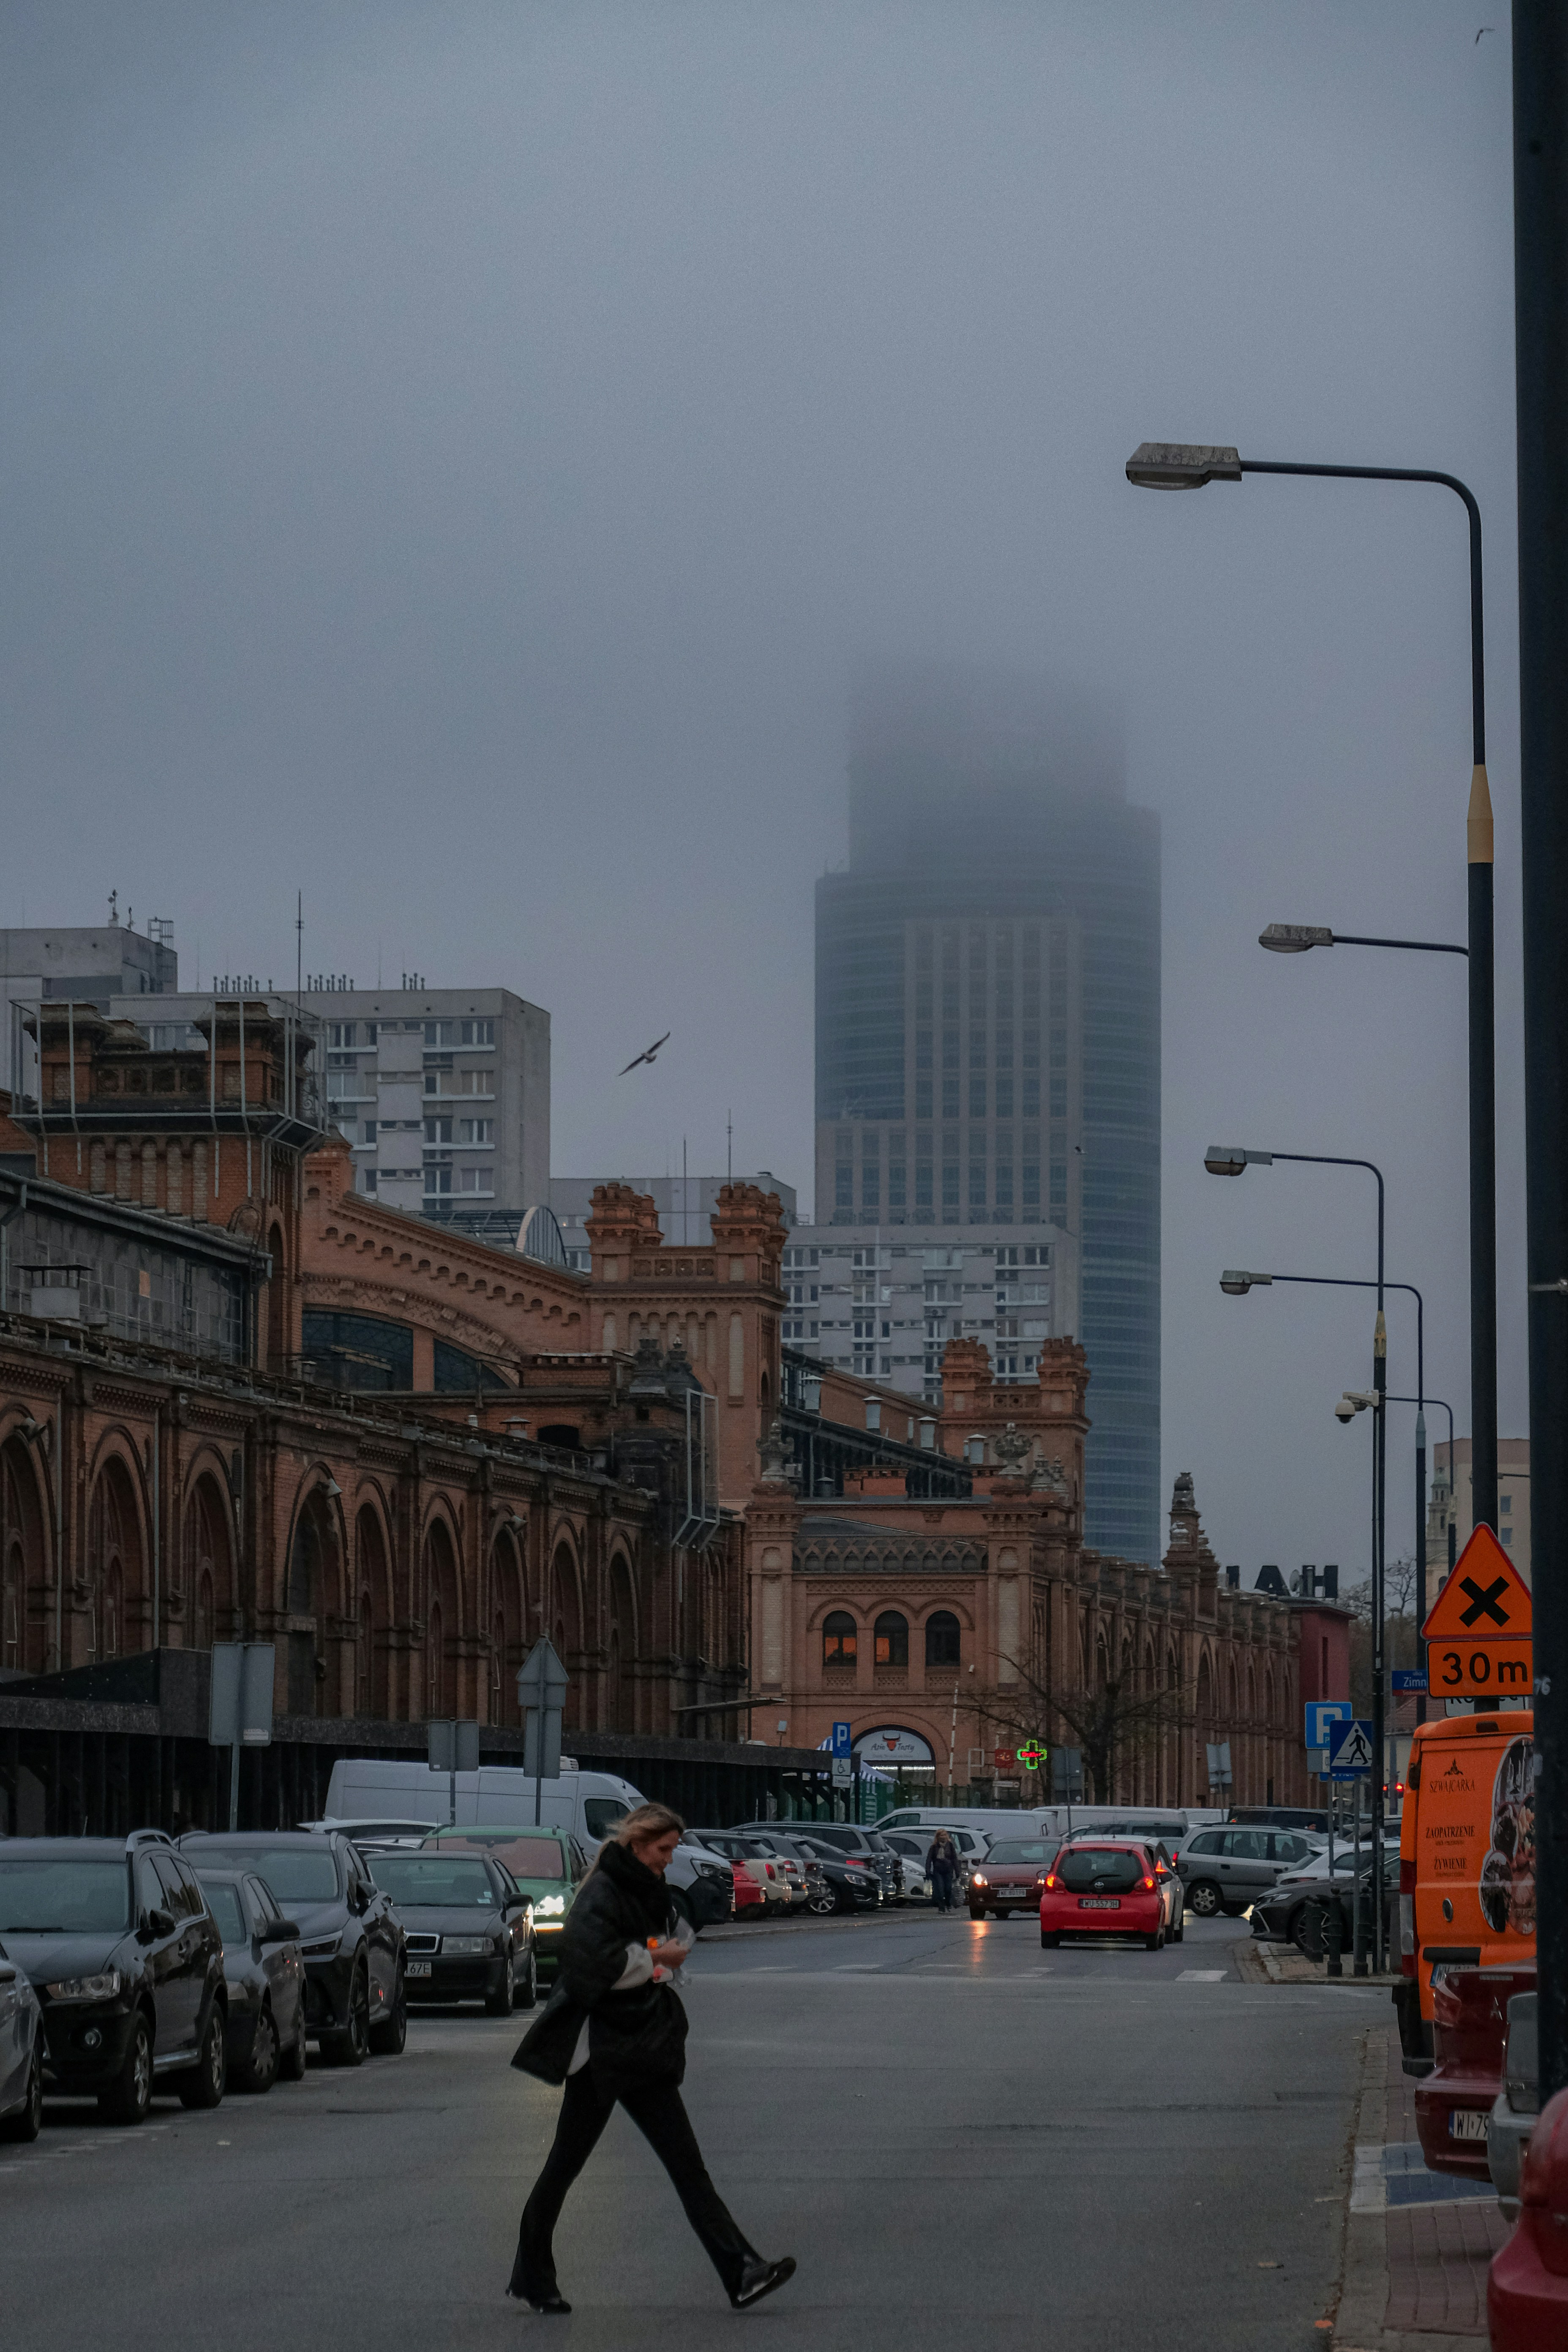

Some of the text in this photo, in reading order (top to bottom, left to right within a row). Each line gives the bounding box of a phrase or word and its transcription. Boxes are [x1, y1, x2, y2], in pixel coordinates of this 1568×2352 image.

[1441, 1652, 1528, 1686] 30 m
[1403, 1677, 1427, 1687] Zimn
[837, 1725, 848, 1747] P
[1429, 1778, 1475, 1794] SZWAJCARKA
[1426, 1825, 1475, 1839] ZAOPATRZENIE
